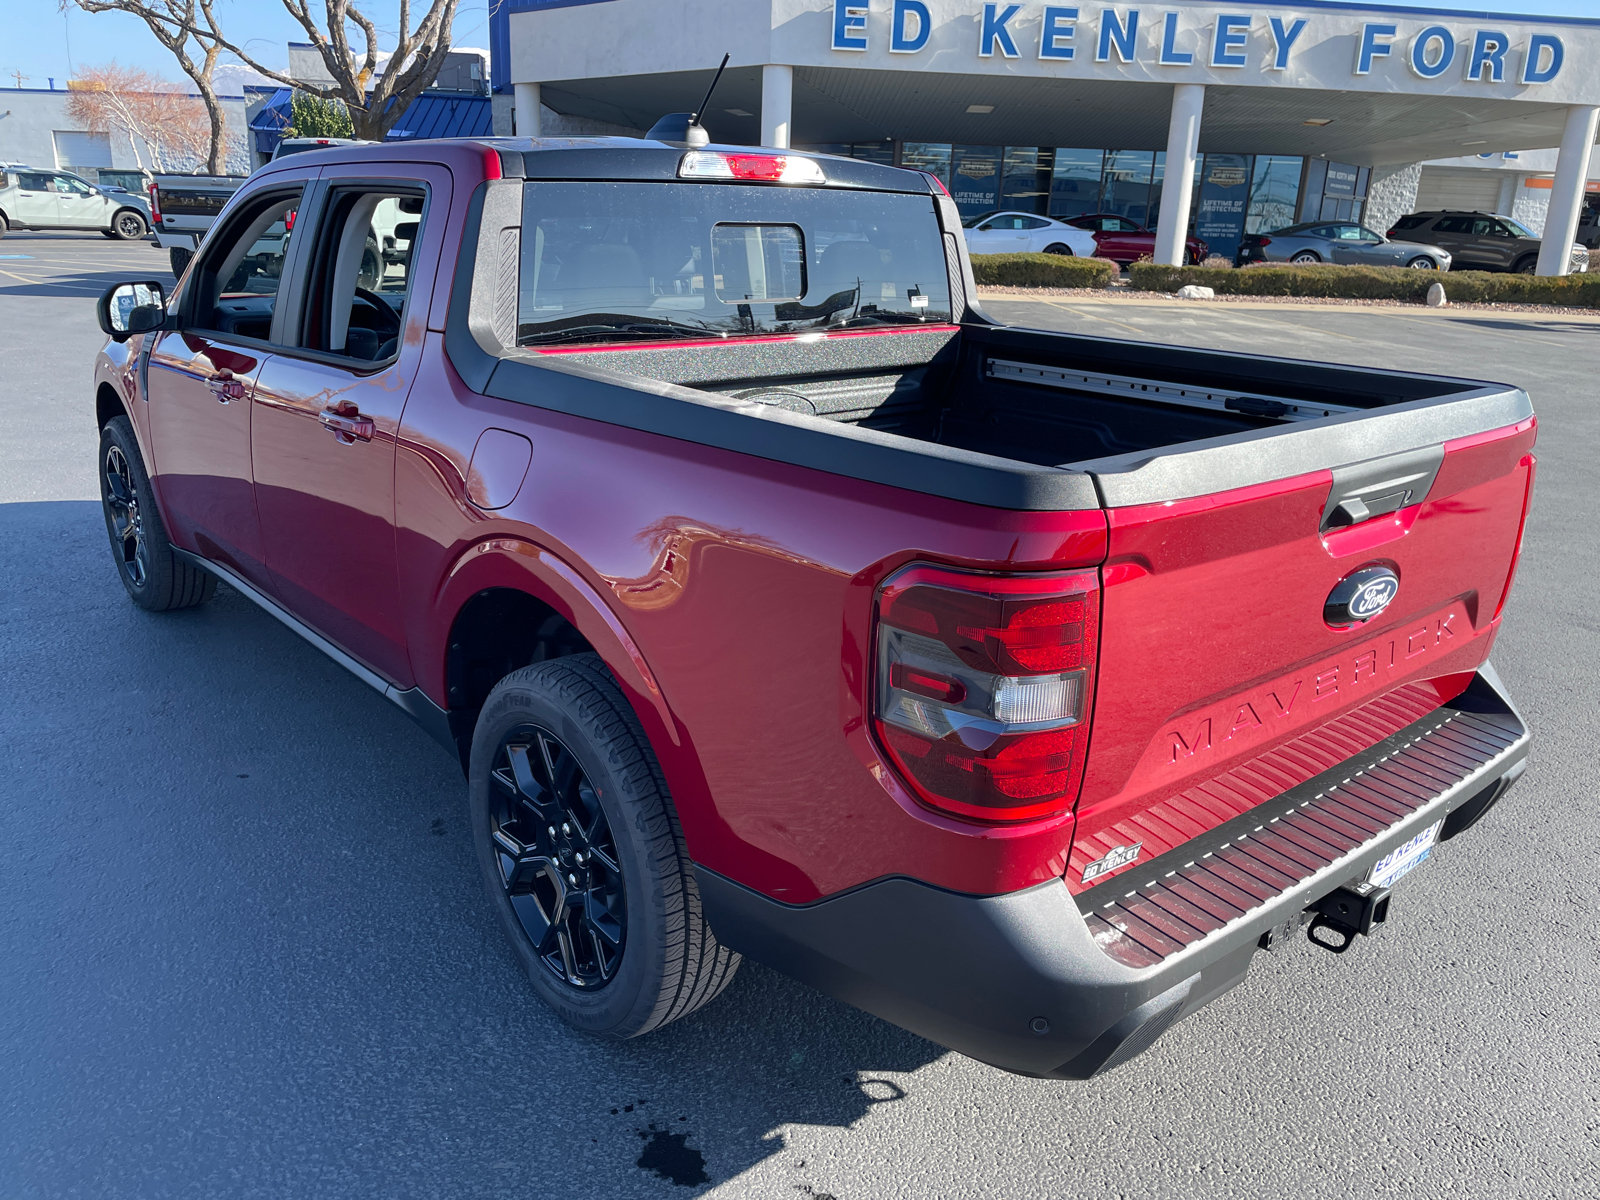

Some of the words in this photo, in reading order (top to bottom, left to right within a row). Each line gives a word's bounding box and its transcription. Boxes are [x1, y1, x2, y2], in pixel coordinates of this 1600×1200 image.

[831, 0, 932, 53] ED
[979, 2, 1308, 71] KENLEY
[1353, 22, 1566, 85] FORD
[1167, 614, 1456, 766] MAVERICK
[1083, 865, 1098, 879] ED
[1100, 845, 1142, 872] KENLEY
[1375, 853, 1394, 873] ED
